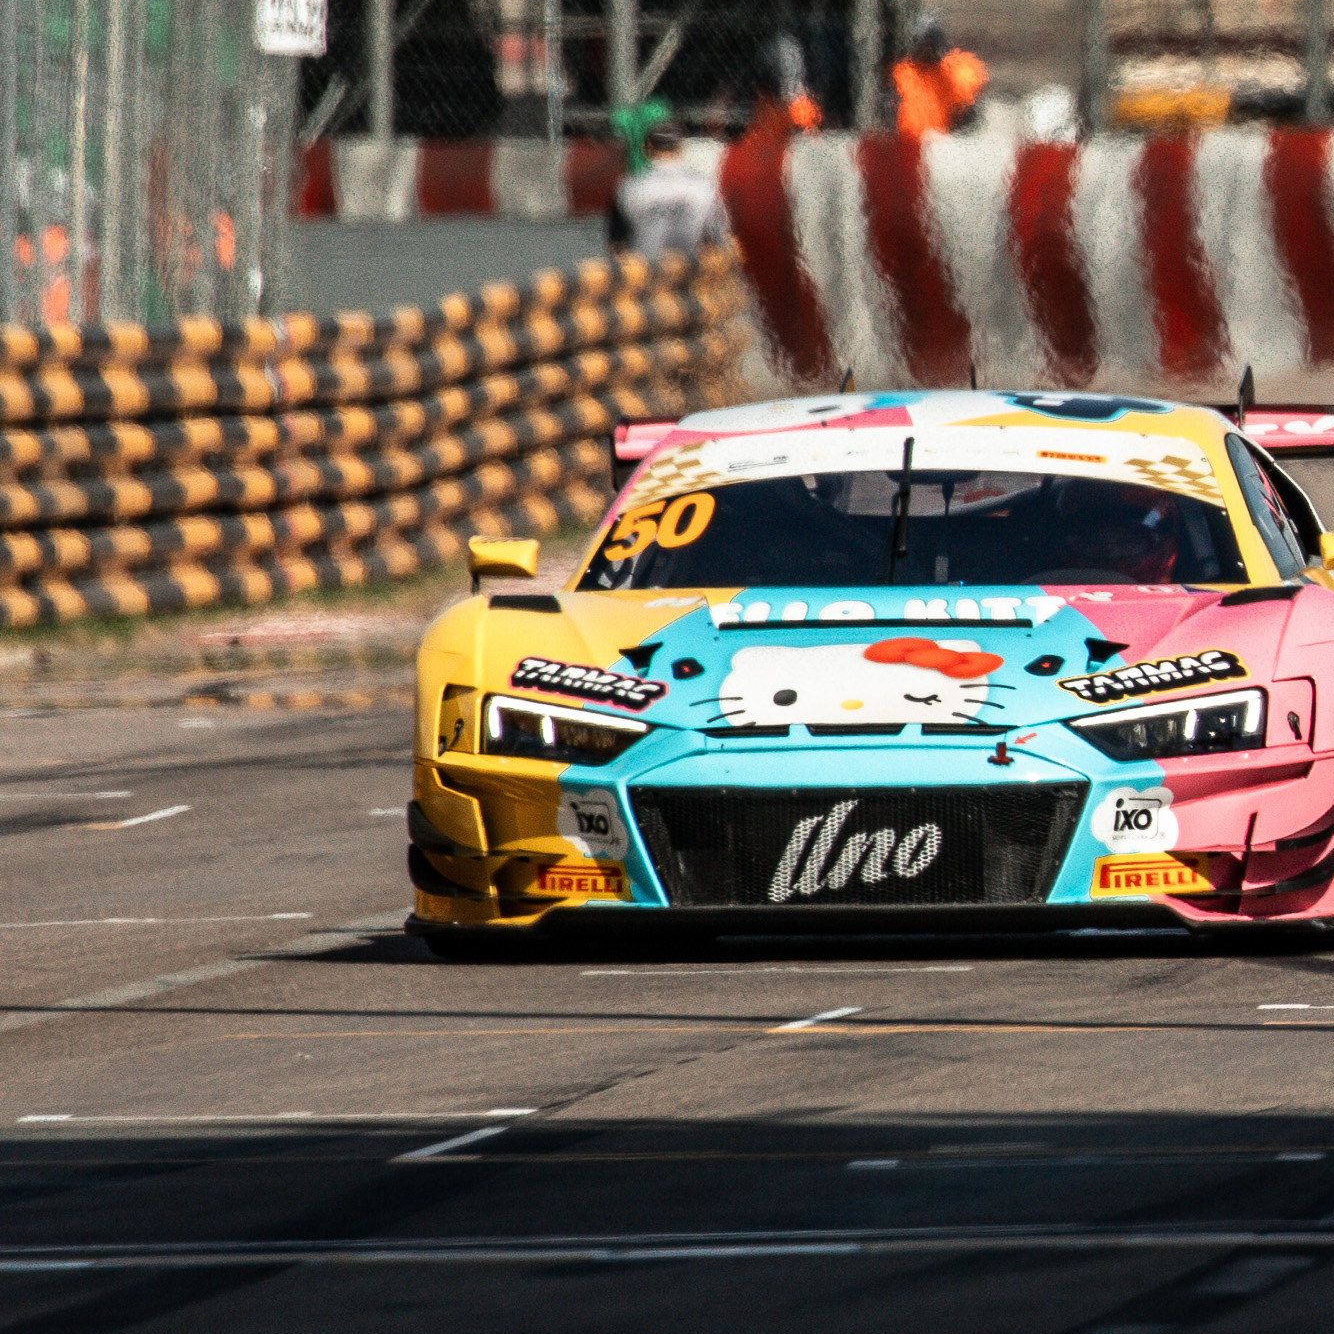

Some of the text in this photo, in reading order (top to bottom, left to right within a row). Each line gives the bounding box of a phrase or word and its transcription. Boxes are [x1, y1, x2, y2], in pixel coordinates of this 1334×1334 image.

[604, 492, 715, 561] 50
[512, 657, 665, 709] TARMAC
[1059, 651, 1248, 703] TARMAC
[538, 864, 624, 893] PIRELLI
[1099, 858, 1199, 889] PIRELLI
